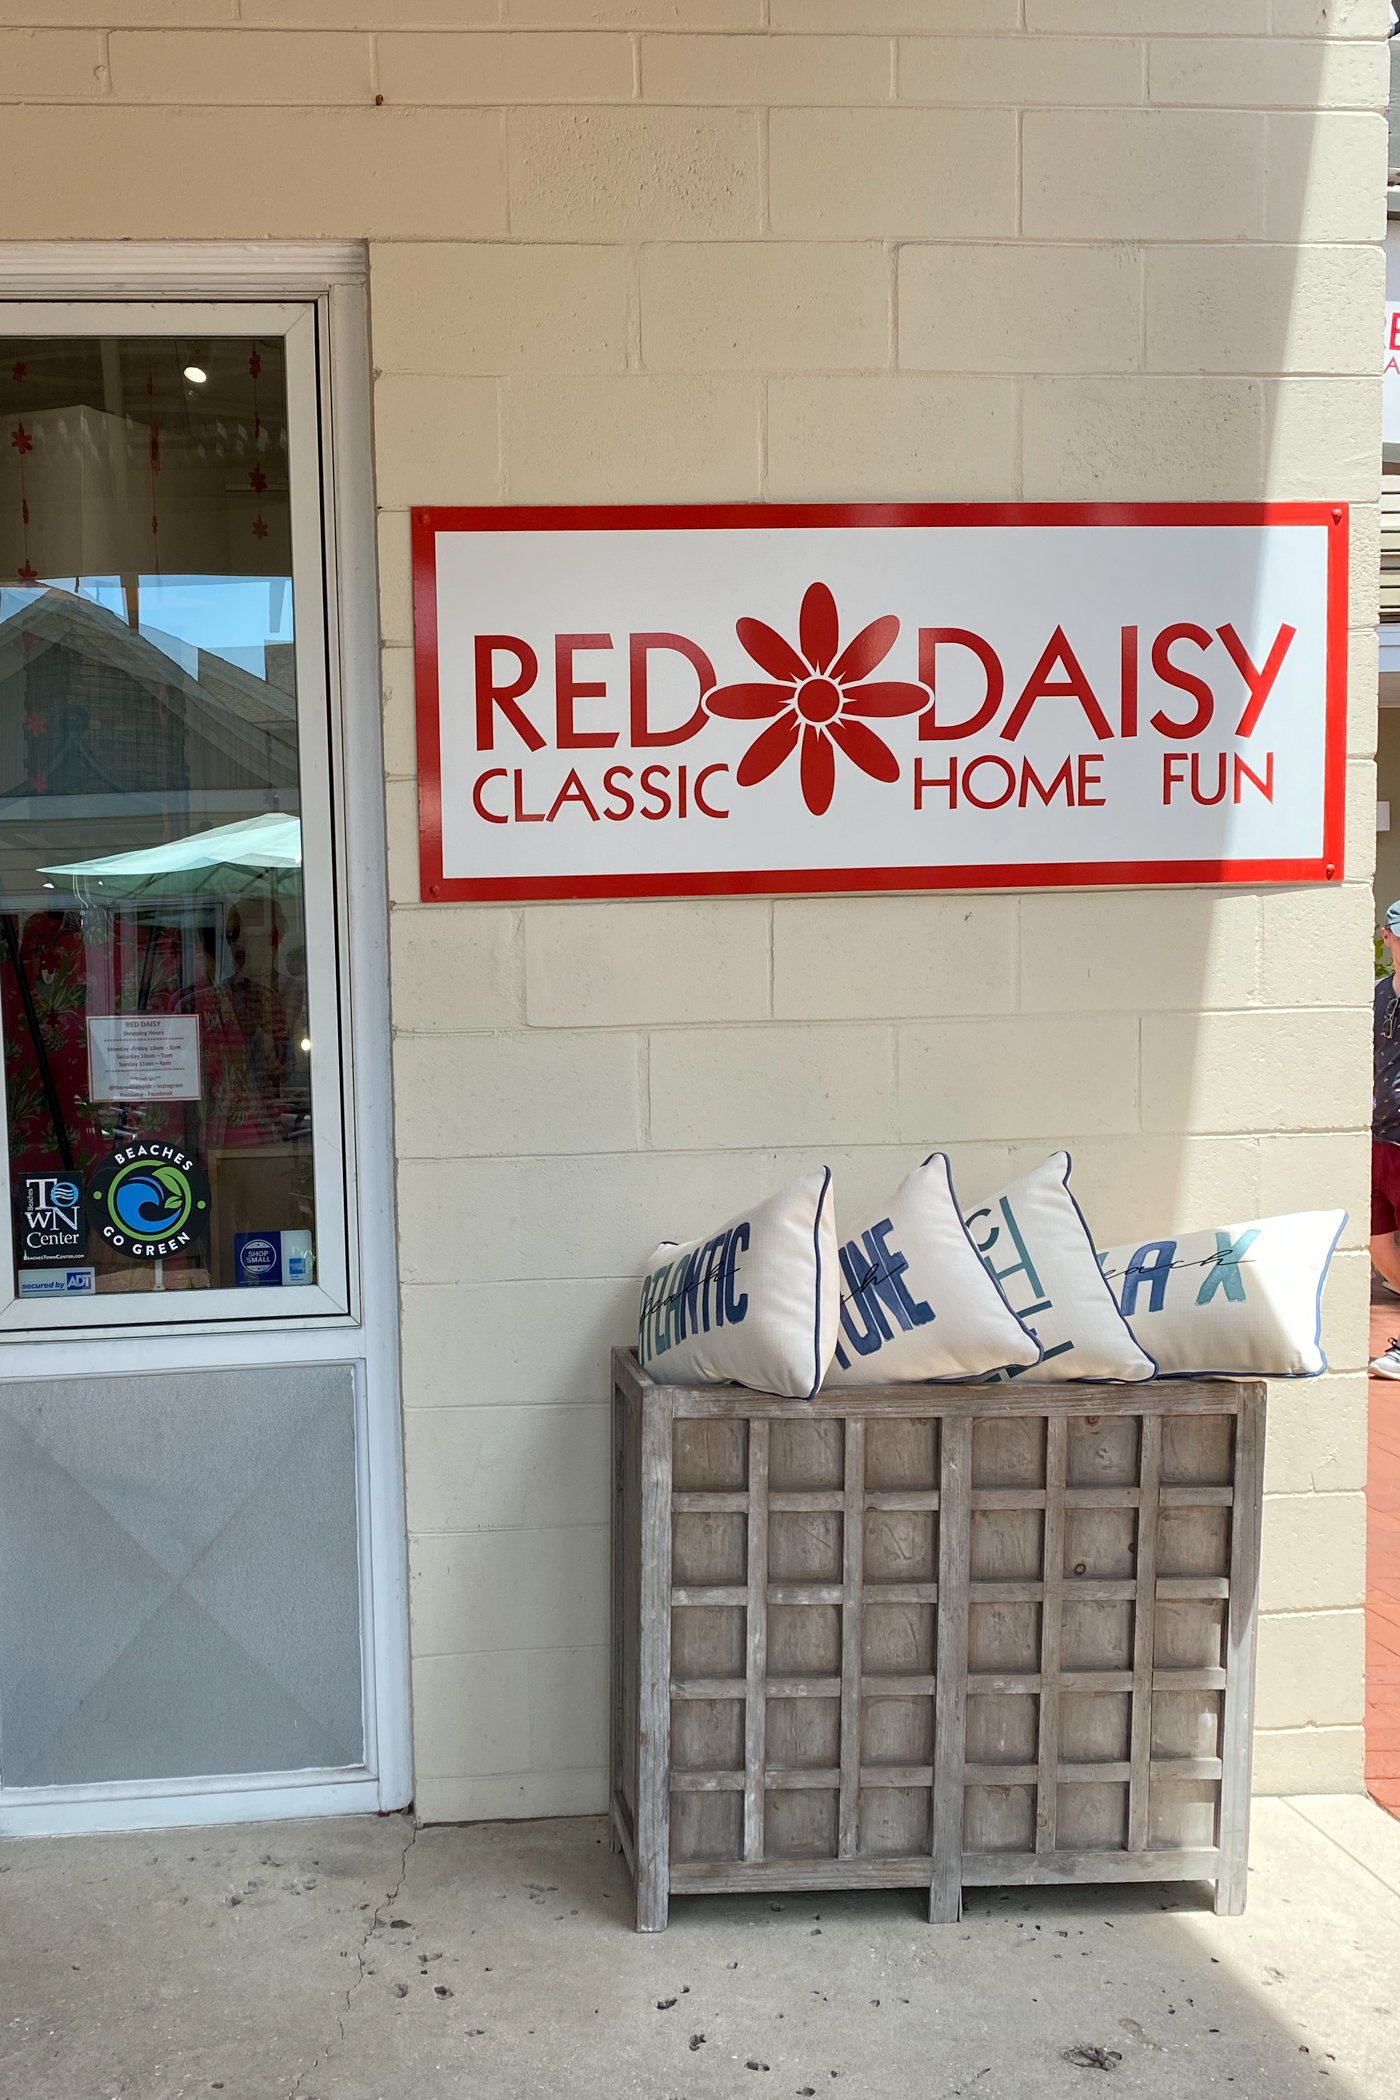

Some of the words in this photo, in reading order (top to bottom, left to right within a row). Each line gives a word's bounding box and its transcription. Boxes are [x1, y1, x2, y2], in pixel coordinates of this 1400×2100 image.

[474, 633, 717, 751] RED
[918, 623, 1297, 741] DAISY
[472, 763, 731, 824] CLASSIC
[913, 753, 1106, 811] HOME
[1162, 752, 1274, 806] FUN
[114, 1144, 194, 1171] BEACHES
[26, 1231, 80, 1249] Center
[103, 1226, 124, 1246] GO
[132, 1231, 191, 1256] GREEN
[246, 1256, 271, 1264] SMALL
[21, 1282, 54, 1290] secured
[55, 1281, 65, 1290] by
[67, 1274, 92, 1288] ADT
[638, 1221, 751, 1367] ATLANTIC
